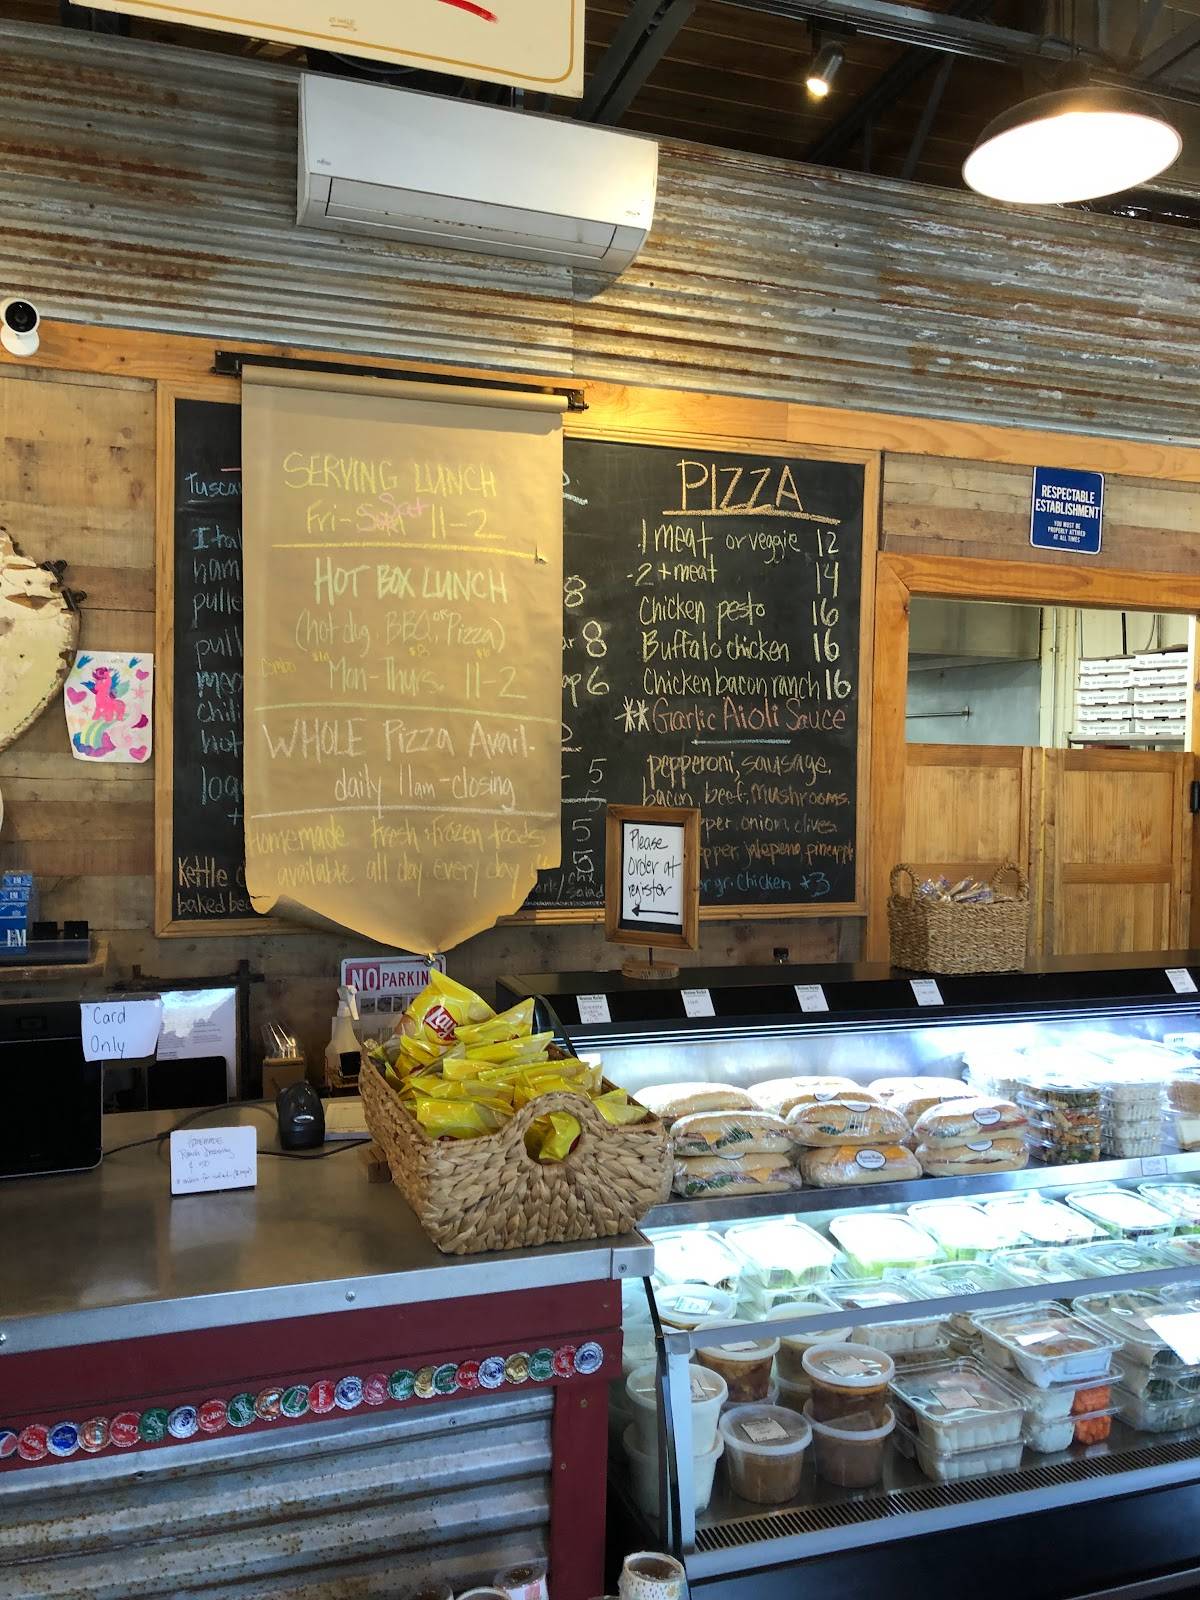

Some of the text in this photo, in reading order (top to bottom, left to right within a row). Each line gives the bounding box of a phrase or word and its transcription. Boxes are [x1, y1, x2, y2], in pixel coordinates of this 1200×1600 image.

[185, 472, 242, 498] Tusca
[283, 451, 497, 497] SERVING LUNCH
[676, 459, 804, 512] PIZZA
[1035, 498, 1100, 519] ESTABLISHMENT
[1041, 484, 1095, 504] RESPECTABLE
[1047, 526, 1068, 534] PROPERLY
[1063, 520, 1075, 528] MUST
[654, 521, 713, 558] meat
[725, 533, 746, 550] or
[750, 529, 801, 564] veggie
[816, 528, 839, 557] 12
[314, 557, 508, 605] HOT BOX LUNCH
[564, 574, 586, 608] 8
[815, 561, 839, 598] 14
[193, 587, 242, 628] pulle
[716, 592, 766, 640] pesto
[813, 597, 839, 627] 16
[195, 626, 242, 670] pull
[583, 620, 607, 657] 8
[642, 630, 722, 662] Buffalo
[813, 632, 840, 663] 16
[587, 665, 610, 696] 6
[715, 667, 768, 698] bacon
[770, 671, 820, 699] ranch
[825, 669, 852, 700] 16
[652, 696, 846, 734] Garlic Aioli Sauce
[262, 717, 368, 764] WHOLE
[383, 719, 455, 761] Pizza
[588, 758, 607, 784] 5
[334, 763, 385, 819] daily
[571, 818, 593, 842] 5
[629, 828, 669, 851] Please
[178, 855, 228, 888] Kettle
[367, 852, 387, 883] all
[397, 851, 423, 897] day
[433, 858, 480, 898] every
[486, 852, 521, 900] day
[572, 848, 594, 873] 5
[663, 855, 682, 878] at
[178, 892, 226, 916] baked
[628, 878, 672, 906] register
[352, 967, 429, 992] NO PARKIN
[93, 1006, 126, 1025] Card
[90, 1035, 126, 1060] Only
